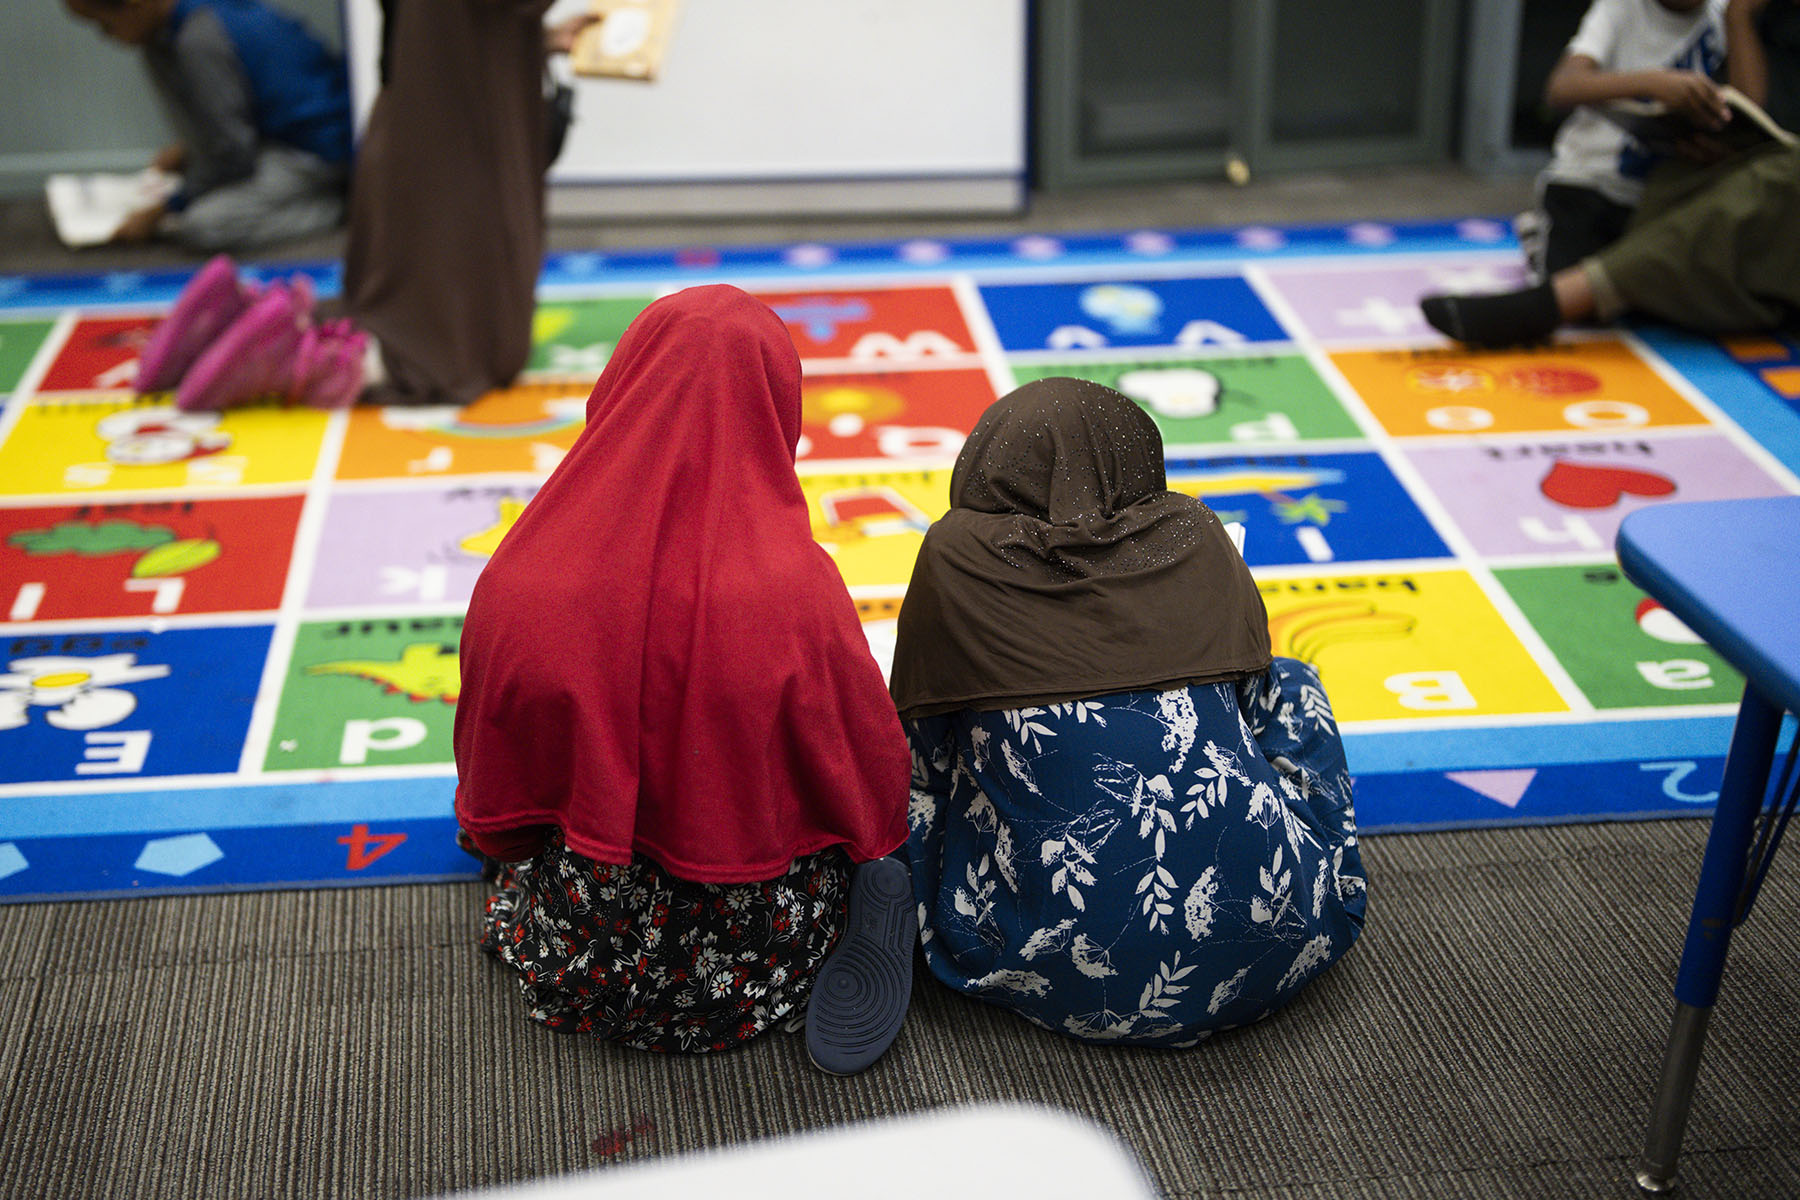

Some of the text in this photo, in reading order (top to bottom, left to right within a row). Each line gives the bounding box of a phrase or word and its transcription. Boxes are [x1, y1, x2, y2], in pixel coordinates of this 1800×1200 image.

[1519, 515, 1604, 550] h
[124, 577, 186, 614] L
[1384, 670, 1479, 711] B
[1636, 659, 1715, 691] a
[75, 729, 153, 775] E
[338, 716, 428, 765] d
[1639, 759, 1720, 803] 2
[336, 823, 408, 871] 4
